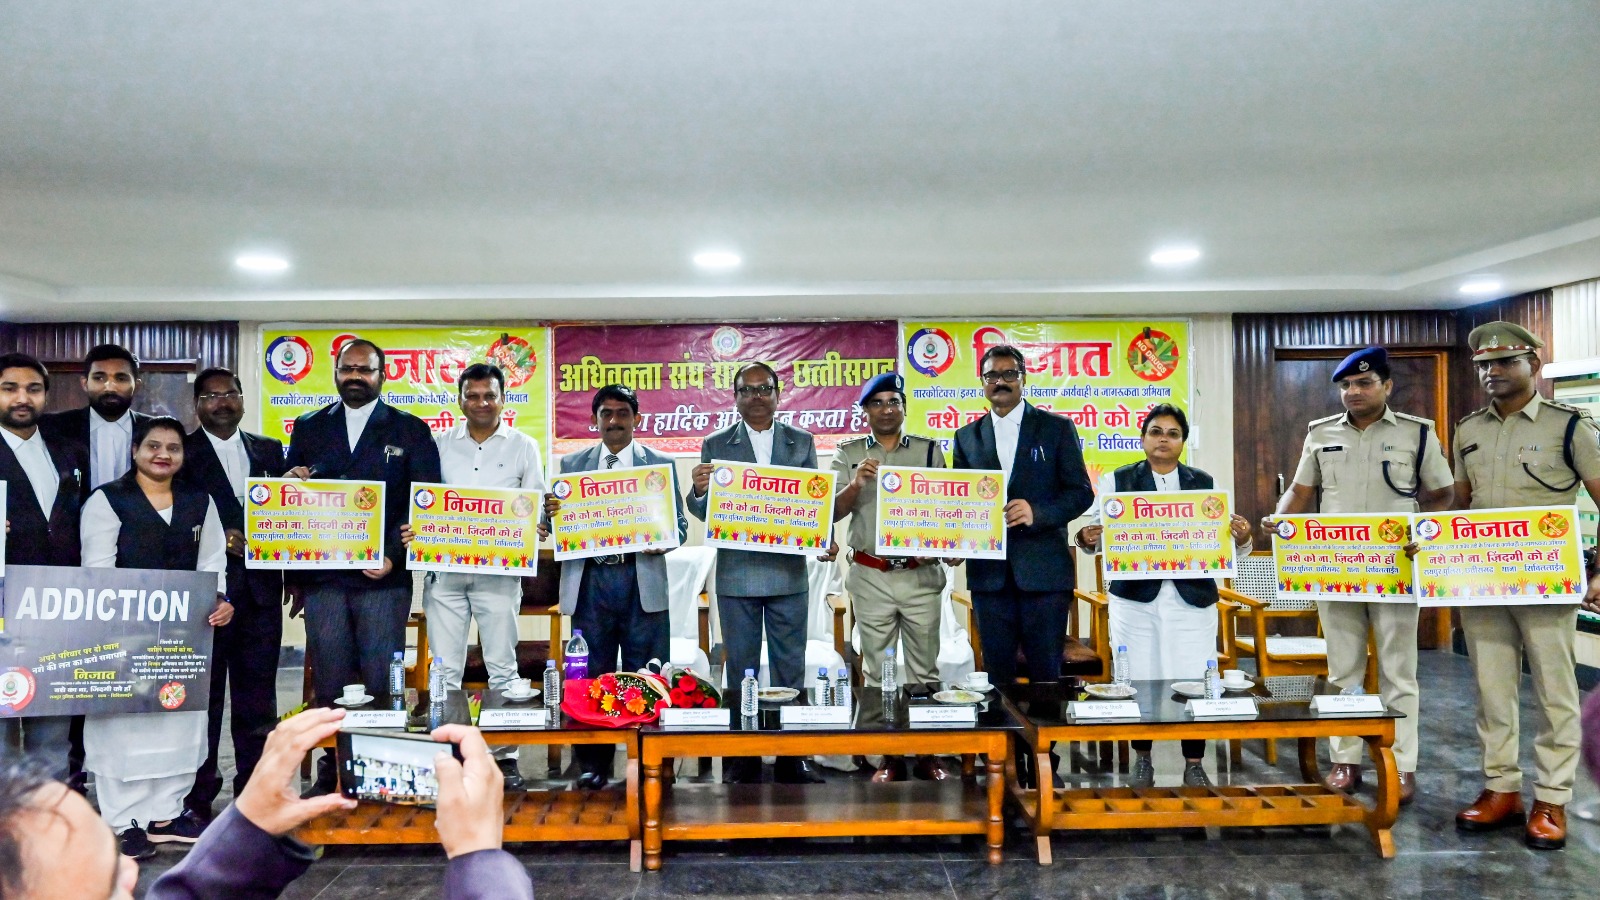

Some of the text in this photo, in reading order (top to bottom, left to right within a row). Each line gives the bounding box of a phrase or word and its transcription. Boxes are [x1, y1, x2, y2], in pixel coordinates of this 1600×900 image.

[1136, 340, 1167, 374] NO DRUGS
[668, 352, 705, 390] संघ
[388, 393, 415, 405] खिलाफ
[503, 393, 528, 404] भियान
[1030, 386, 1058, 398] खिलाफ
[1061, 386, 1092, 398] कार्यवाही
[1094, 389, 1099, 397] व
[1101, 388, 1140, 398] जागरूकता
[1142, 386, 1170, 397] अभियान
[654, 405, 710, 434] हार्दिक
[799, 410, 848, 428] करता
[928, 406, 960, 428] नशे
[1105, 404, 1130, 428] को
[1098, 433, 1143, 450] सिविलल
[579, 477, 638, 498] निजात
[742, 469, 801, 495] निजात
[910, 473, 970, 496] निजात
[280, 484, 346, 507] निजात
[443, 490, 505, 515] निजात
[563, 508, 576, 522] नशे
[579, 510, 590, 520] को
[636, 504, 648, 513] को
[720, 500, 733, 510] नशे
[736, 502, 747, 512] को
[794, 507, 805, 517] को
[889, 506, 903, 516] नशे
[906, 507, 917, 517] को
[965, 510, 976, 519] को
[1133, 497, 1194, 519] निजात
[258, 520, 272, 530] नशे
[276, 520, 288, 530] को
[342, 520, 353, 530] को
[421, 523, 435, 533] नशे
[438, 524, 450, 534] को
[498, 527, 510, 537] को
[1305, 519, 1370, 541] निजात
[1451, 517, 1530, 540] निजात
[1114, 531, 1128, 541] नशे
[1131, 532, 1143, 541] को
[1192, 530, 1204, 539] को
[1286, 553, 1301, 562] नशे
[1303, 554, 1315, 563] को
[1368, 553, 1381, 563] को
[1429, 554, 1446, 564] नशे
[1450, 553, 1464, 564] को
[1527, 550, 1542, 560] को
[16, 586, 190, 622] ADDICTION
[39, 653, 56, 662] अपने
[58, 650, 82, 659] परिवार
[94, 645, 102, 653] दो
[103, 642, 120, 650] ध्यान
[32, 665, 44, 674] नशे
[47, 662, 56, 671] की
[72, 658, 83, 666] का
[84, 655, 97, 664] करो
[74, 668, 116, 680] निजात
